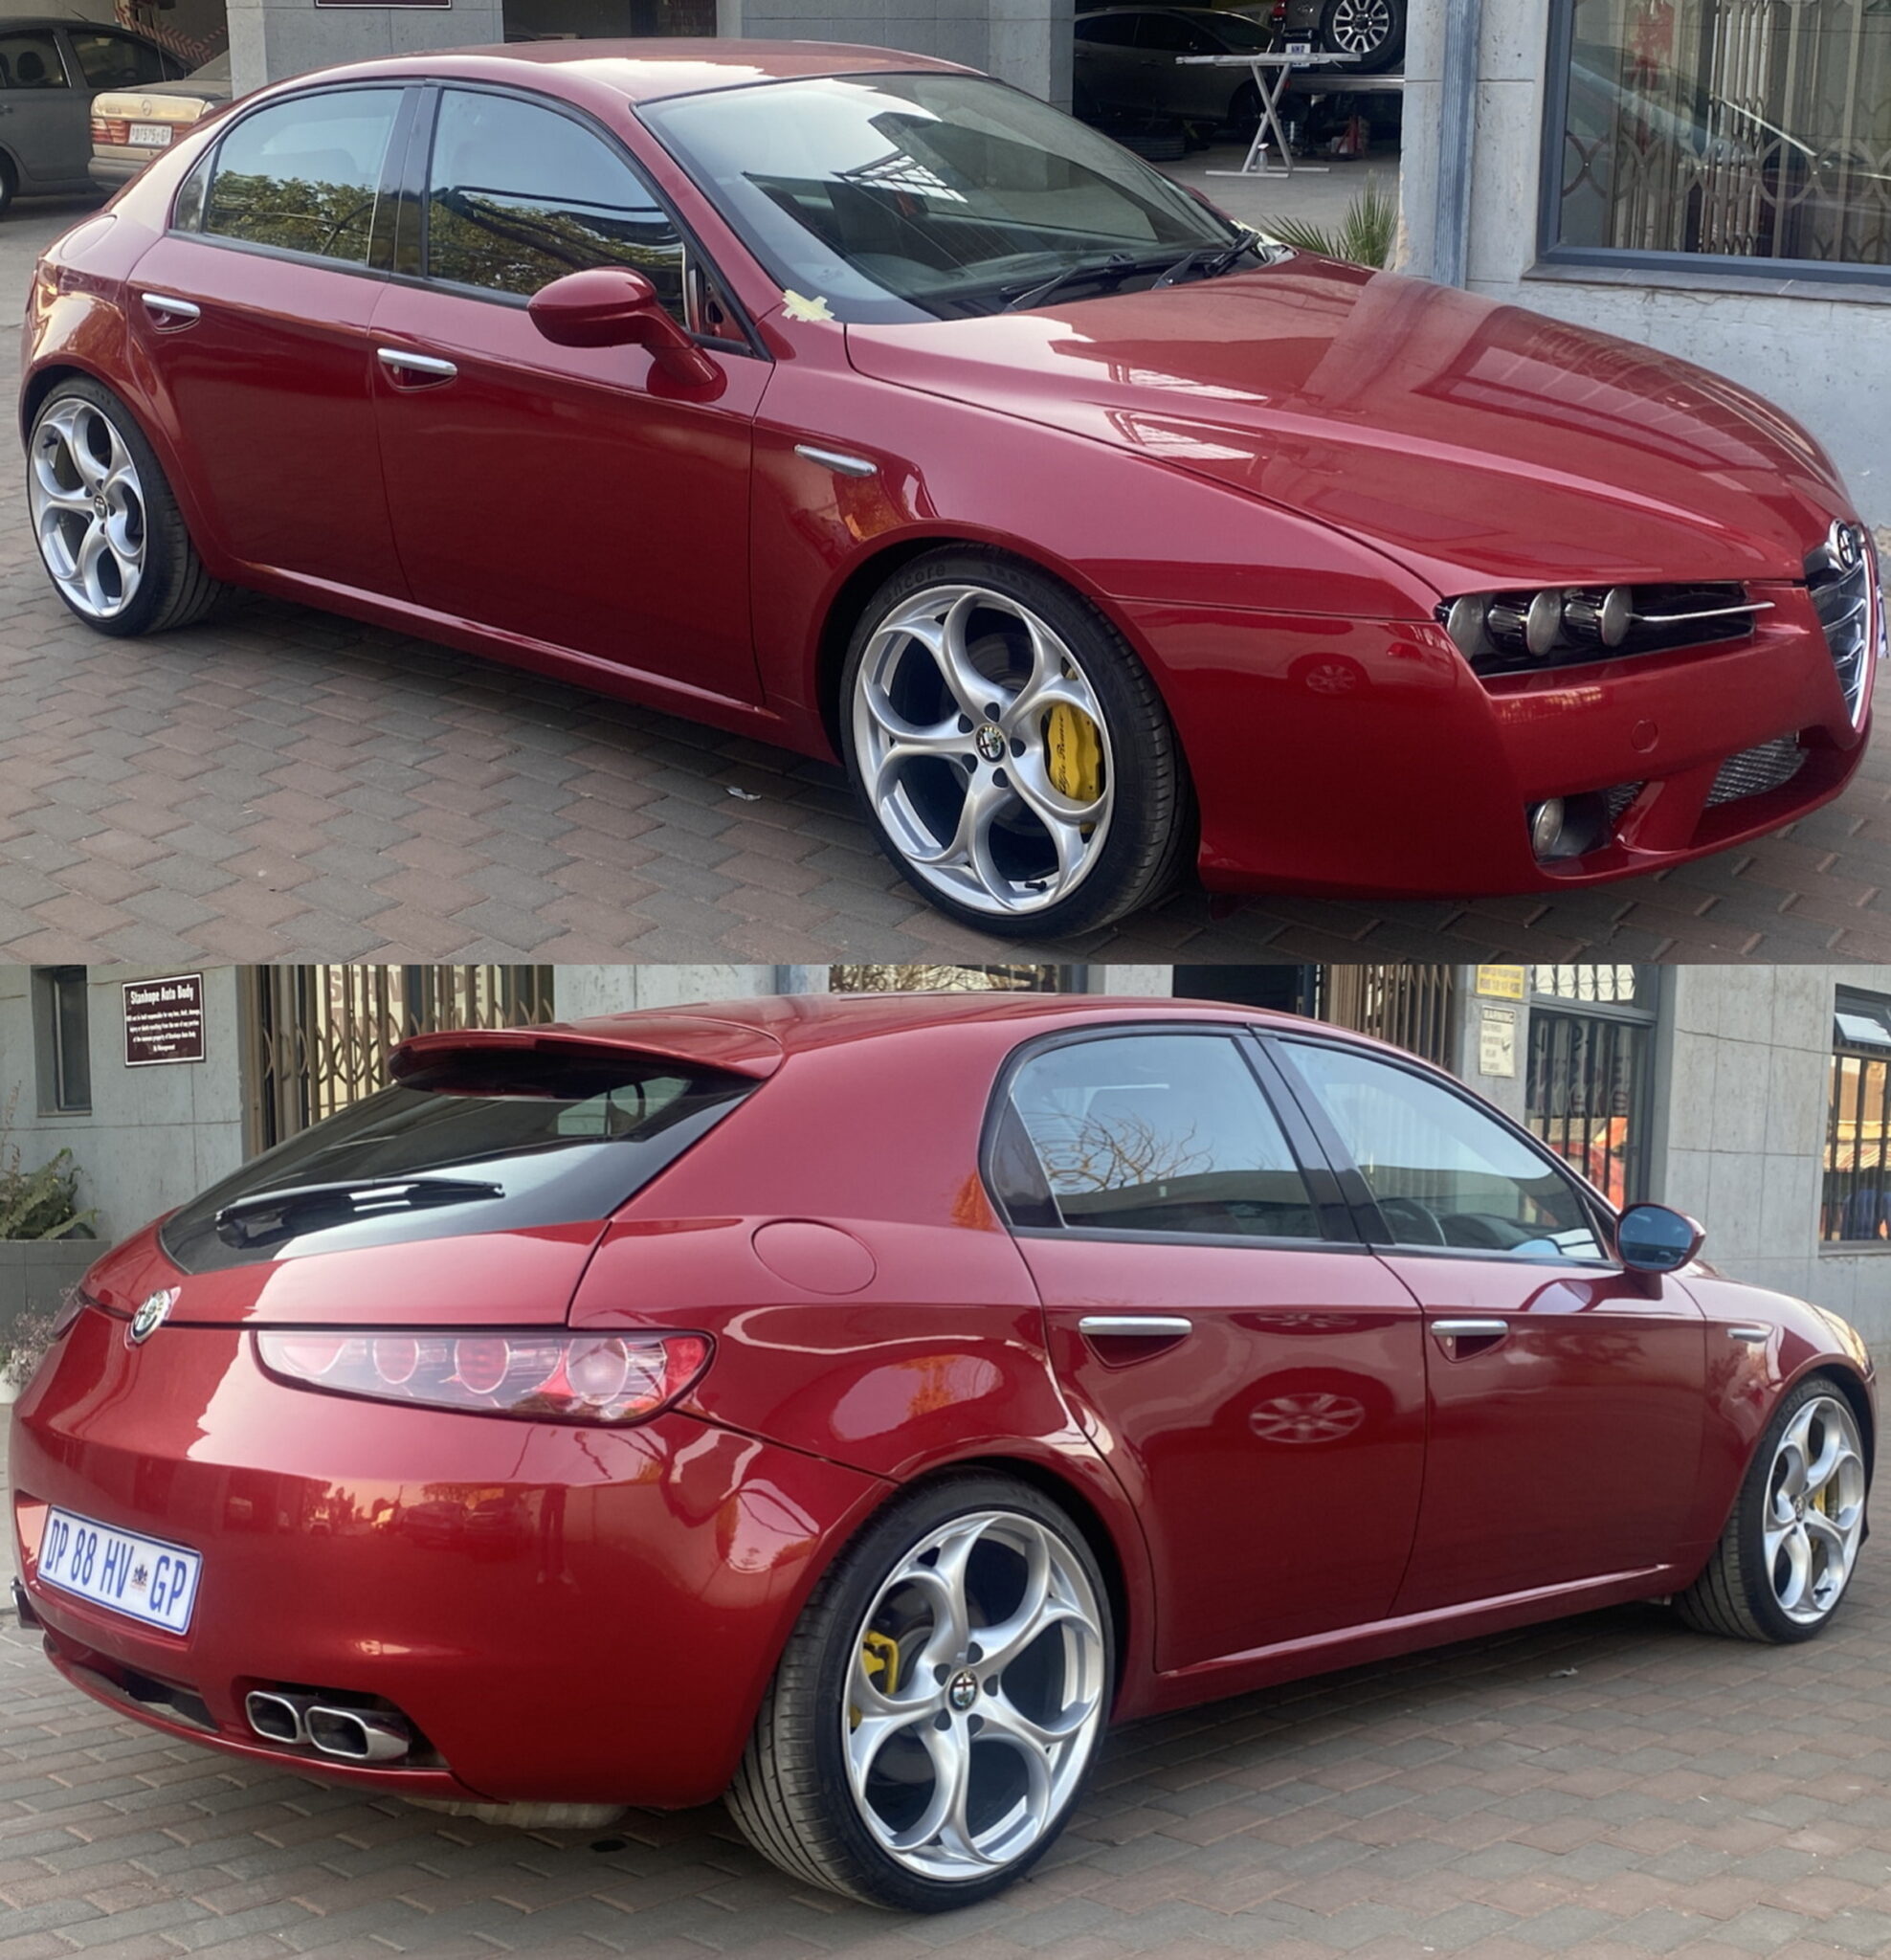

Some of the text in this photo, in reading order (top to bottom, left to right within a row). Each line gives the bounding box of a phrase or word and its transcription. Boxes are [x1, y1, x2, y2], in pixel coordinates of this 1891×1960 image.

[1057, 712, 1065, 760] Romeo
[130, 984, 193, 1005] Stanhope Auto Body
[45, 1519, 187, 1616] DP 88 HV GP
